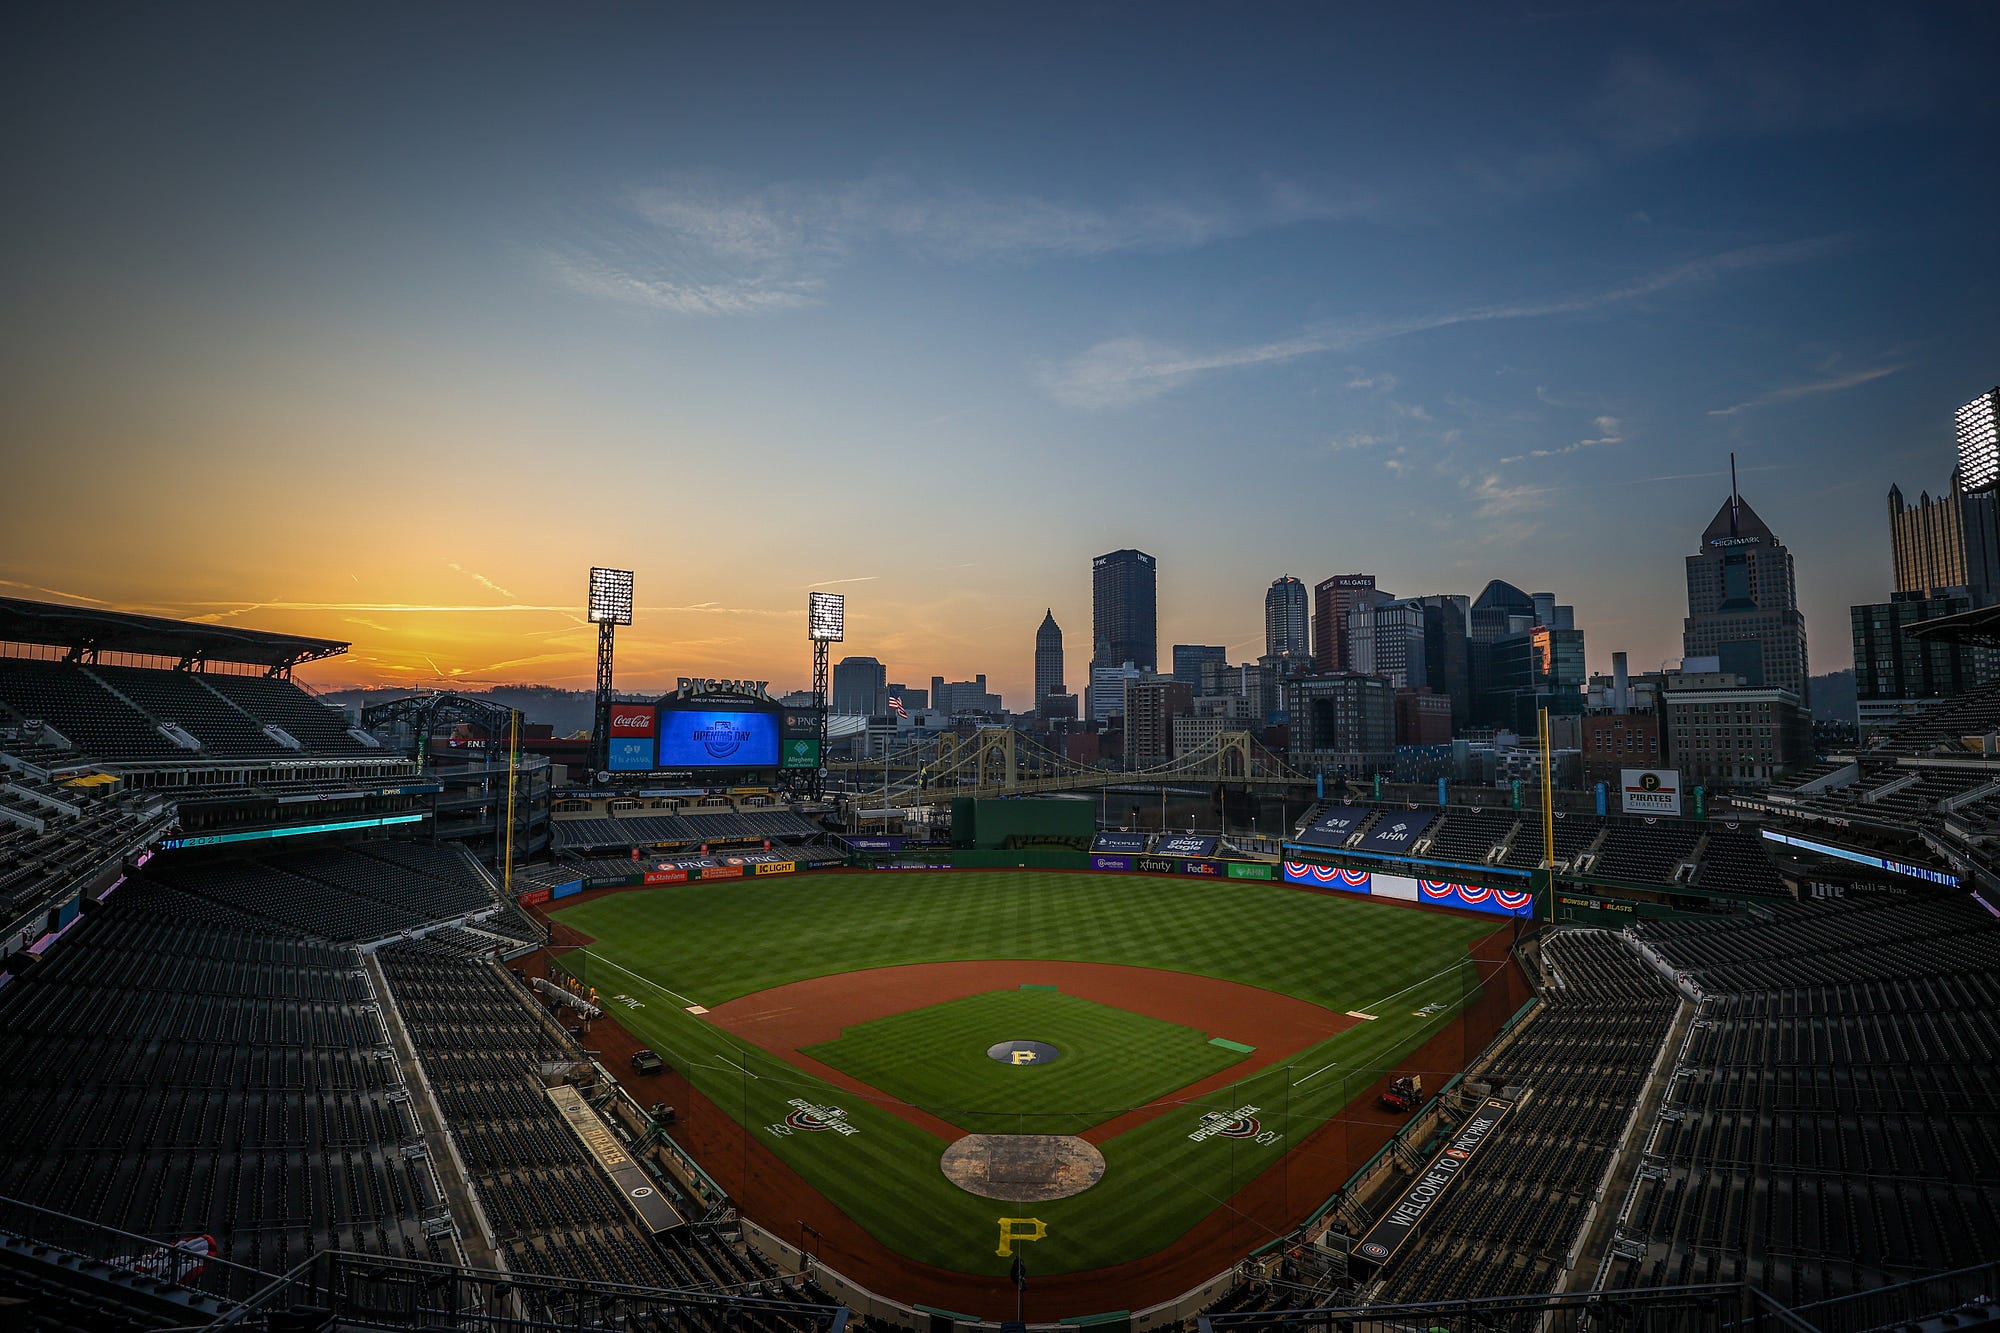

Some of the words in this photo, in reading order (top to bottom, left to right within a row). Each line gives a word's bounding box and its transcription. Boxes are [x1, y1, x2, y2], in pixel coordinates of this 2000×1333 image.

[1714, 536, 1760, 548] HIGHMARK
[676, 677, 717, 701] PNC
[721, 679, 770, 703] PARK
[797, 717, 818, 726] PNC
[693, 730, 733, 741] OPENING
[734, 731, 751, 741] DAY
[788, 756, 814, 764] Allegheny
[1645, 777, 1655, 789] P
[1630, 793, 1672, 803] PIRATES
[1630, 801, 1673, 809] CHARITIES
[190, 836, 222, 846] 2021
[1375, 832, 1409, 841] AHN
[1170, 839, 1205, 847] giant
[744, 855, 779, 863] PNC
[675, 860, 714, 869] PNC
[759, 865, 769, 873] IC
[769, 863, 792, 872] LIGHT
[1139, 858, 1172, 873] xfinity
[1187, 863, 1215, 875] FedEx
[1809, 881, 1845, 900] Lite
[1889, 885, 1908, 895] bar
[1607, 903, 1633, 913] BLASTS
[1010, 1050, 1037, 1066] P
[1487, 1101, 1507, 1111] P
[786, 1098, 833, 1121] OPENING
[824, 1117, 861, 1137] WEEK
[1188, 1117, 1235, 1142] OPENING
[1231, 1104, 1261, 1121] WEEK
[584, 1129, 627, 1166] PIRATES
[1387, 1171, 1450, 1227] WELCOME
[1434, 1158, 1460, 1174] TO
[1452, 1134, 1480, 1155] PNC
[1470, 1117, 1494, 1137] PARK
[995, 1217, 1048, 1258] P
